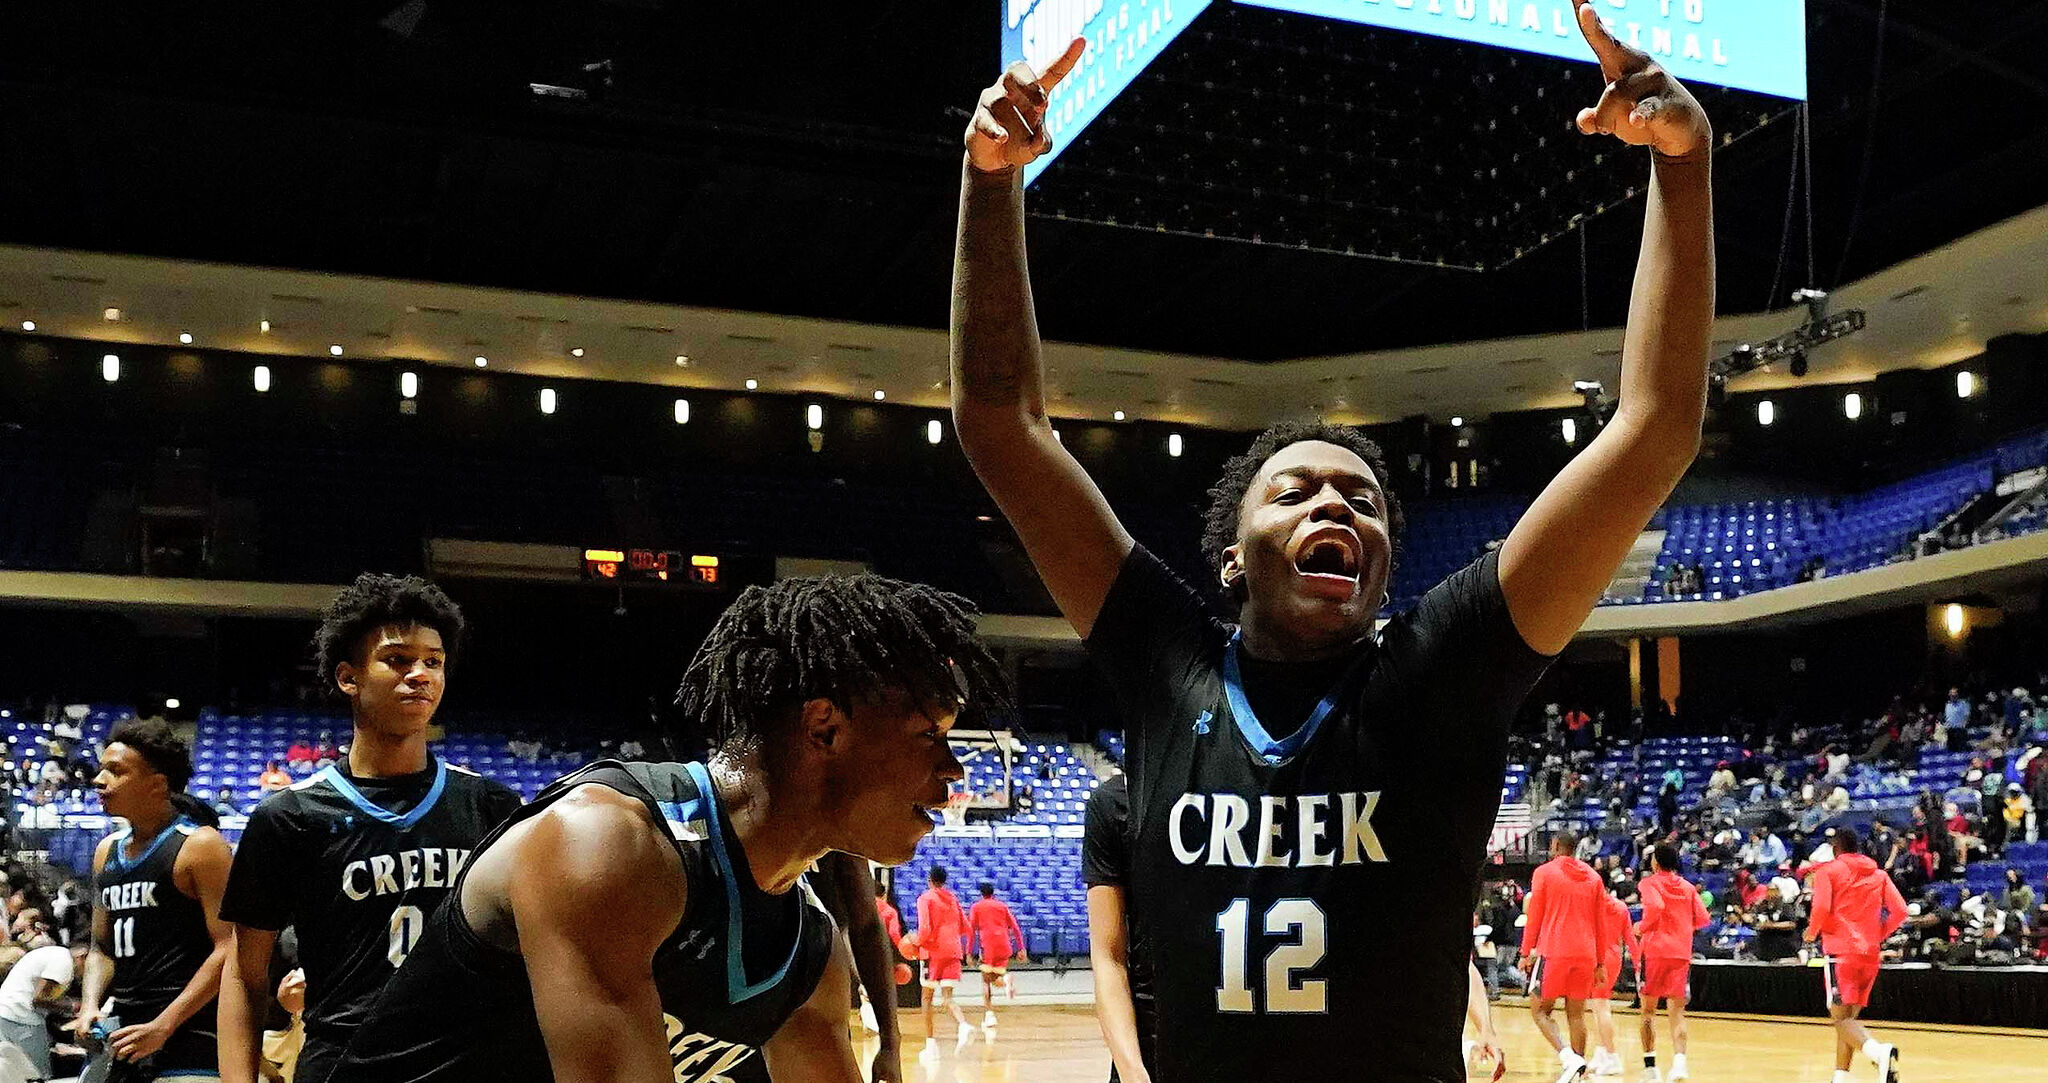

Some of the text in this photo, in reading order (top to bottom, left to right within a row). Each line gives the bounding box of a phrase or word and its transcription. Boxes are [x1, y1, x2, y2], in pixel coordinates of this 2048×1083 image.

[700, 567, 717, 583] 73
[1168, 790, 1390, 868] CREEK
[102, 881, 159, 911] CREEK
[114, 916, 135, 958] 11
[388, 905, 424, 968] 0
[1215, 897, 1329, 1015] 12
